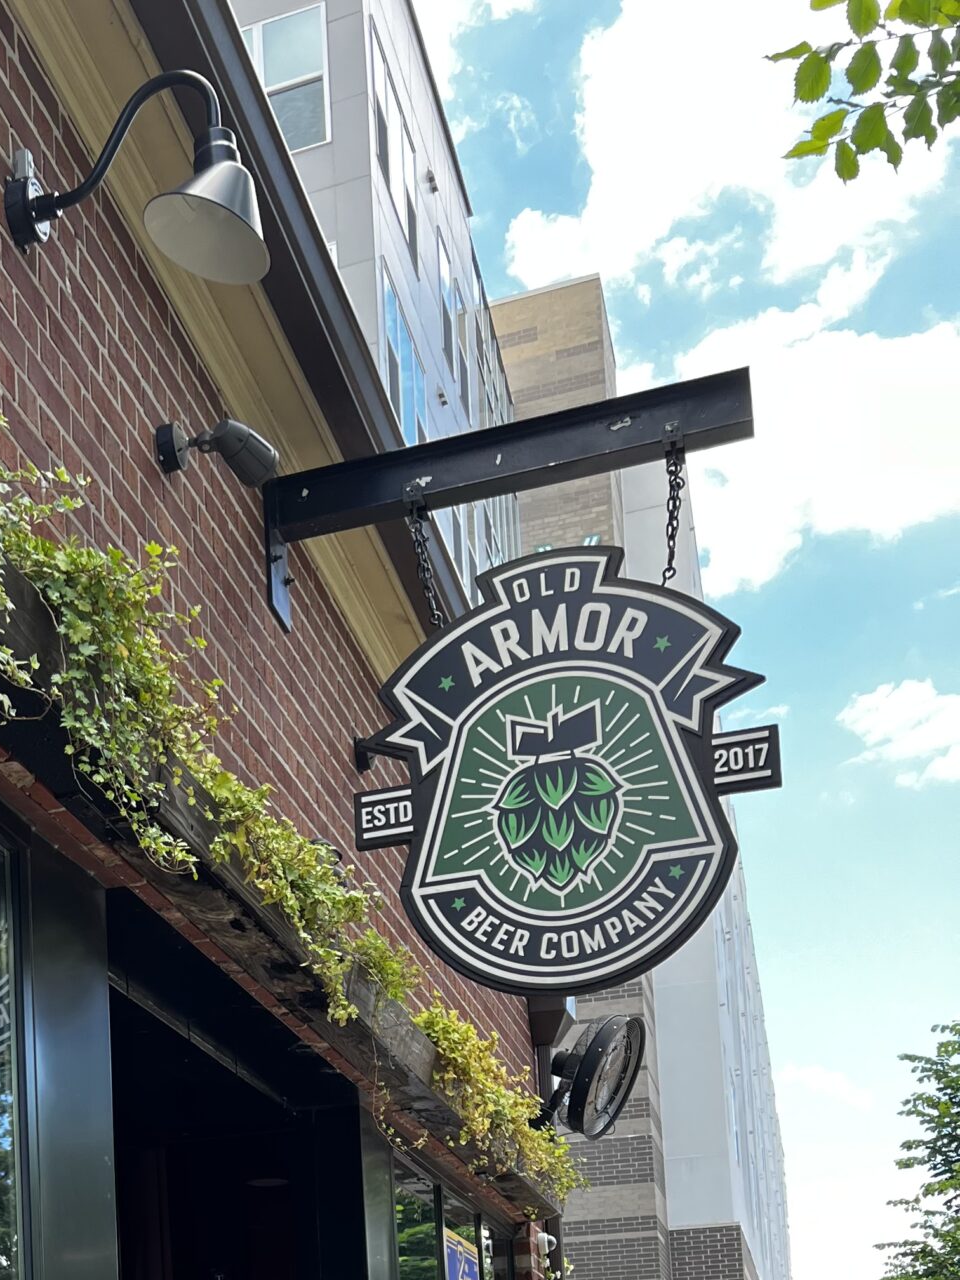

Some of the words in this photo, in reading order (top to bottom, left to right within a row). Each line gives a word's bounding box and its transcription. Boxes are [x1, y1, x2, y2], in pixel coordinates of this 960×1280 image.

[512, 567, 581, 604] OLD
[461, 602, 649, 688] ARMOR
[714, 743, 769, 773] 2017
[361, 800, 413, 830] ESTD
[460, 904, 530, 958] BEER
[540, 876, 677, 961] COMPANY
